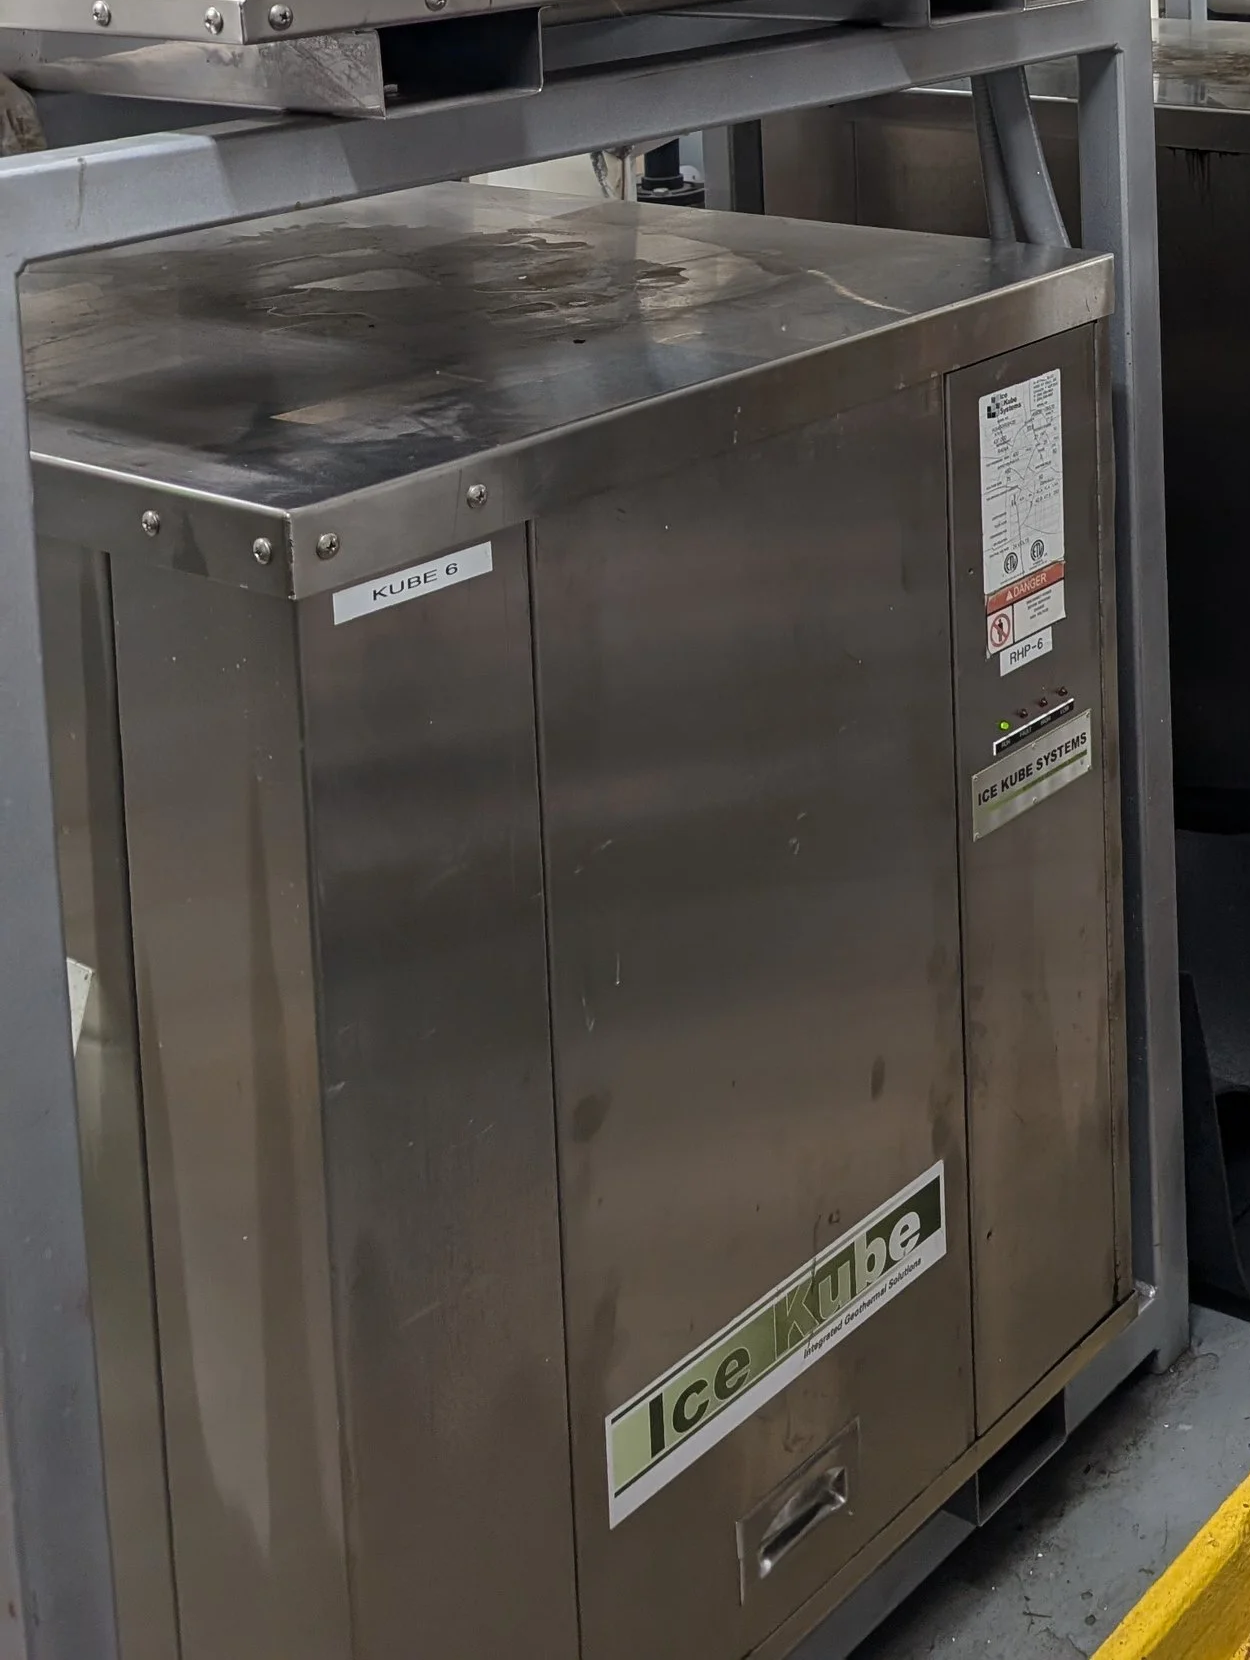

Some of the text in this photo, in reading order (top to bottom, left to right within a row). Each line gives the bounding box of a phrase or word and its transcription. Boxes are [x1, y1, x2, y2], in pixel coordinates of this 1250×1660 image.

[372, 562, 458, 601] KUBE 6
[1013, 573, 1048, 597] DANGER
[1009, 637, 1044, 665] RHP-6
[977, 783, 998, 806] ICE
[1001, 762, 1034, 793] KUBE
[1036, 731, 1087, 771] SYSTEMS
[647, 1210, 922, 1460] Ice Kube
[803, 1257, 922, 1359] Integrated Geothermal Solutions
